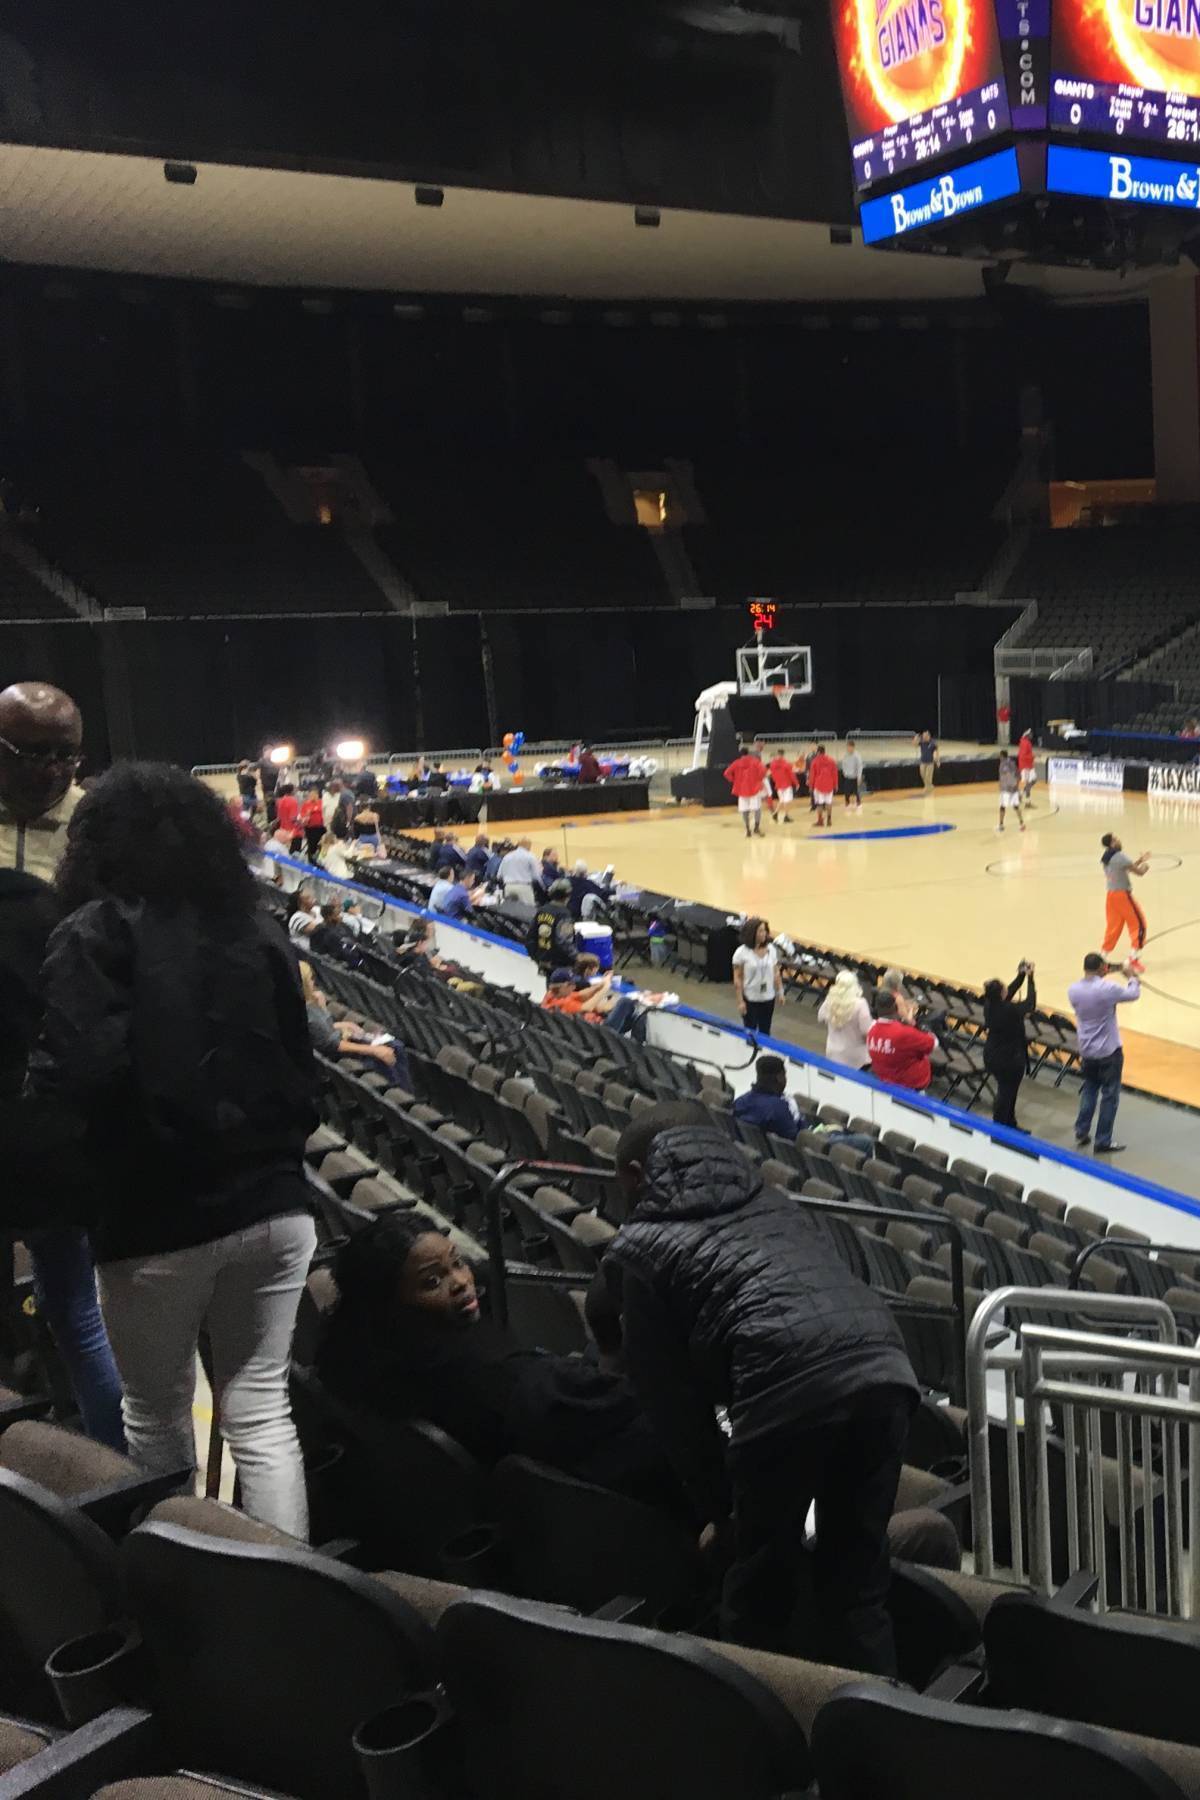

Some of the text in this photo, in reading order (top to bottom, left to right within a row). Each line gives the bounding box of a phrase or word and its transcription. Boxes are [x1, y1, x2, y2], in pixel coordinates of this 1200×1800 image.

[1014, 0, 1036, 105] TS.COM
[1054, 79, 1094, 99] GIANTS
[987, 109, 996, 130] 0
[1070, 104, 1082, 125] 0
[864, 161, 872, 179] 0
[750, 603, 775, 614] 26:14
[754, 613, 773, 630] 24
